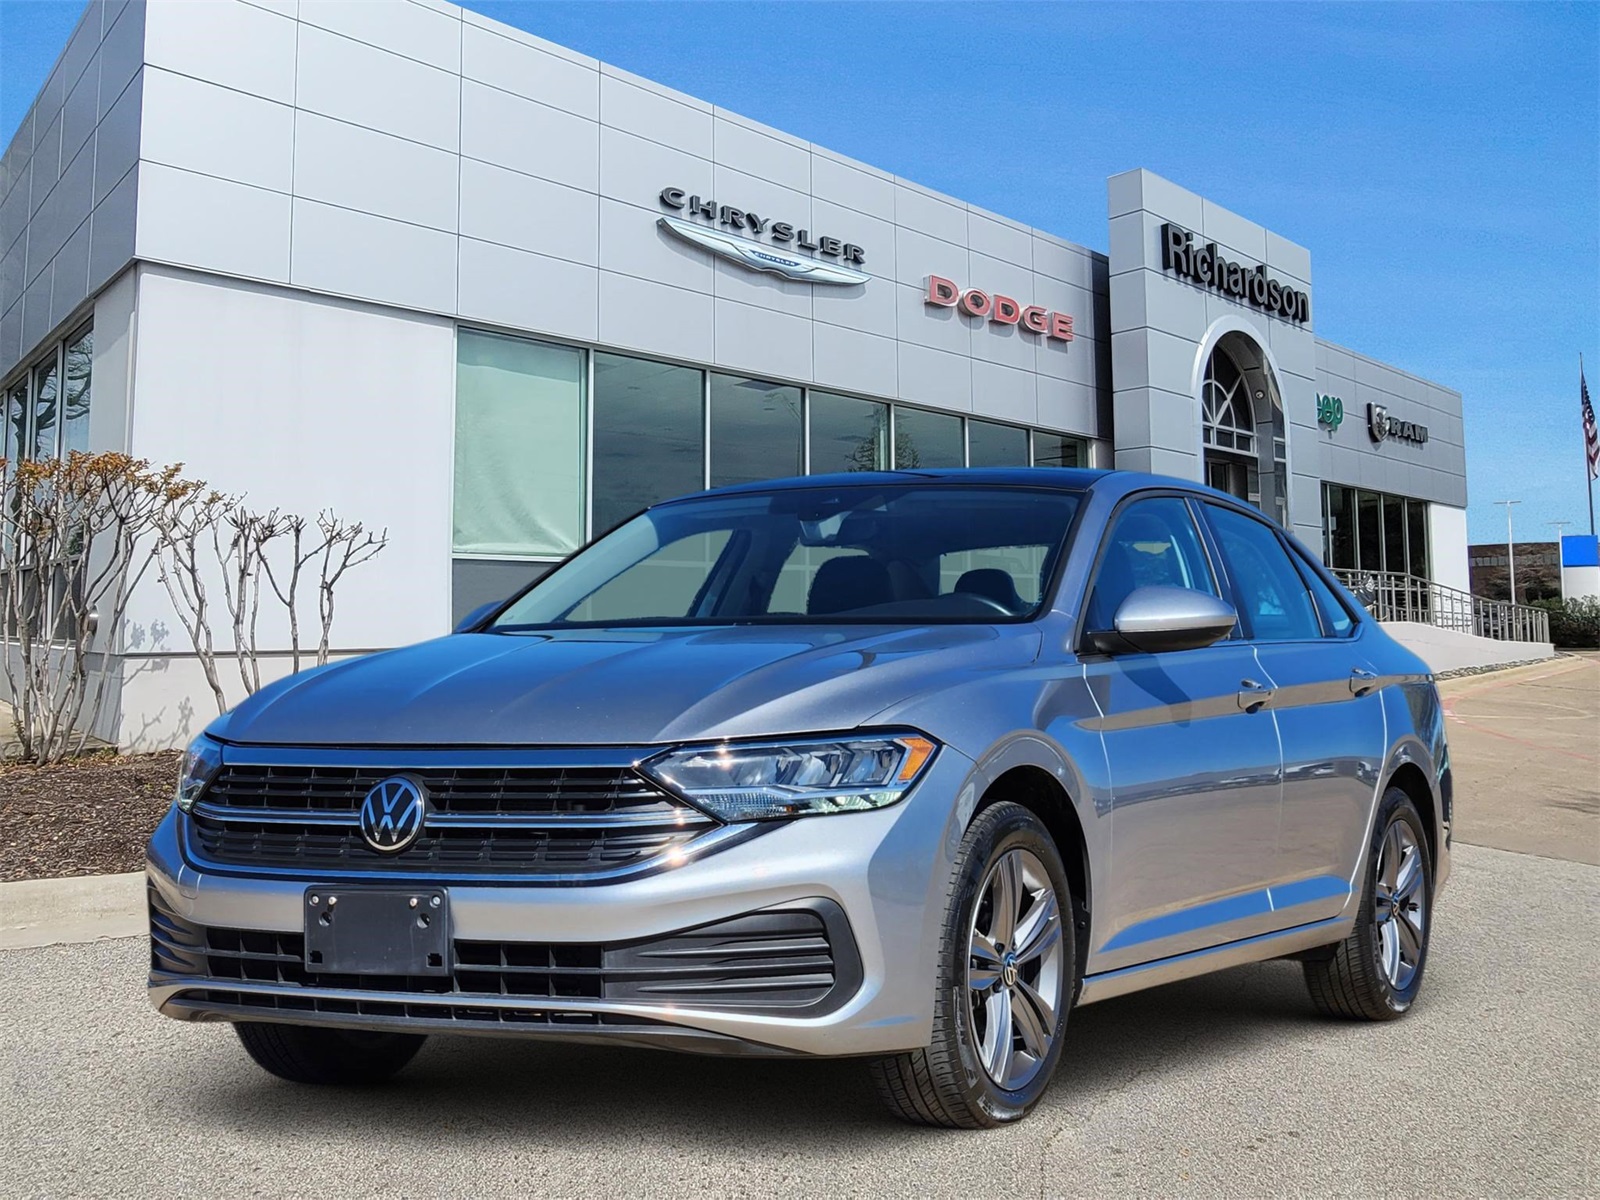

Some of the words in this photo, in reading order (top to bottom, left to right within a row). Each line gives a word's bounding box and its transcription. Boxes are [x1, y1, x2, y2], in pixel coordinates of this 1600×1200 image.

[660, 186, 866, 264] CHRYSLER
[923, 274, 1075, 342] DODGE
[1161, 223, 1310, 323] Richardson
[1386, 416, 1429, 443] RAM
